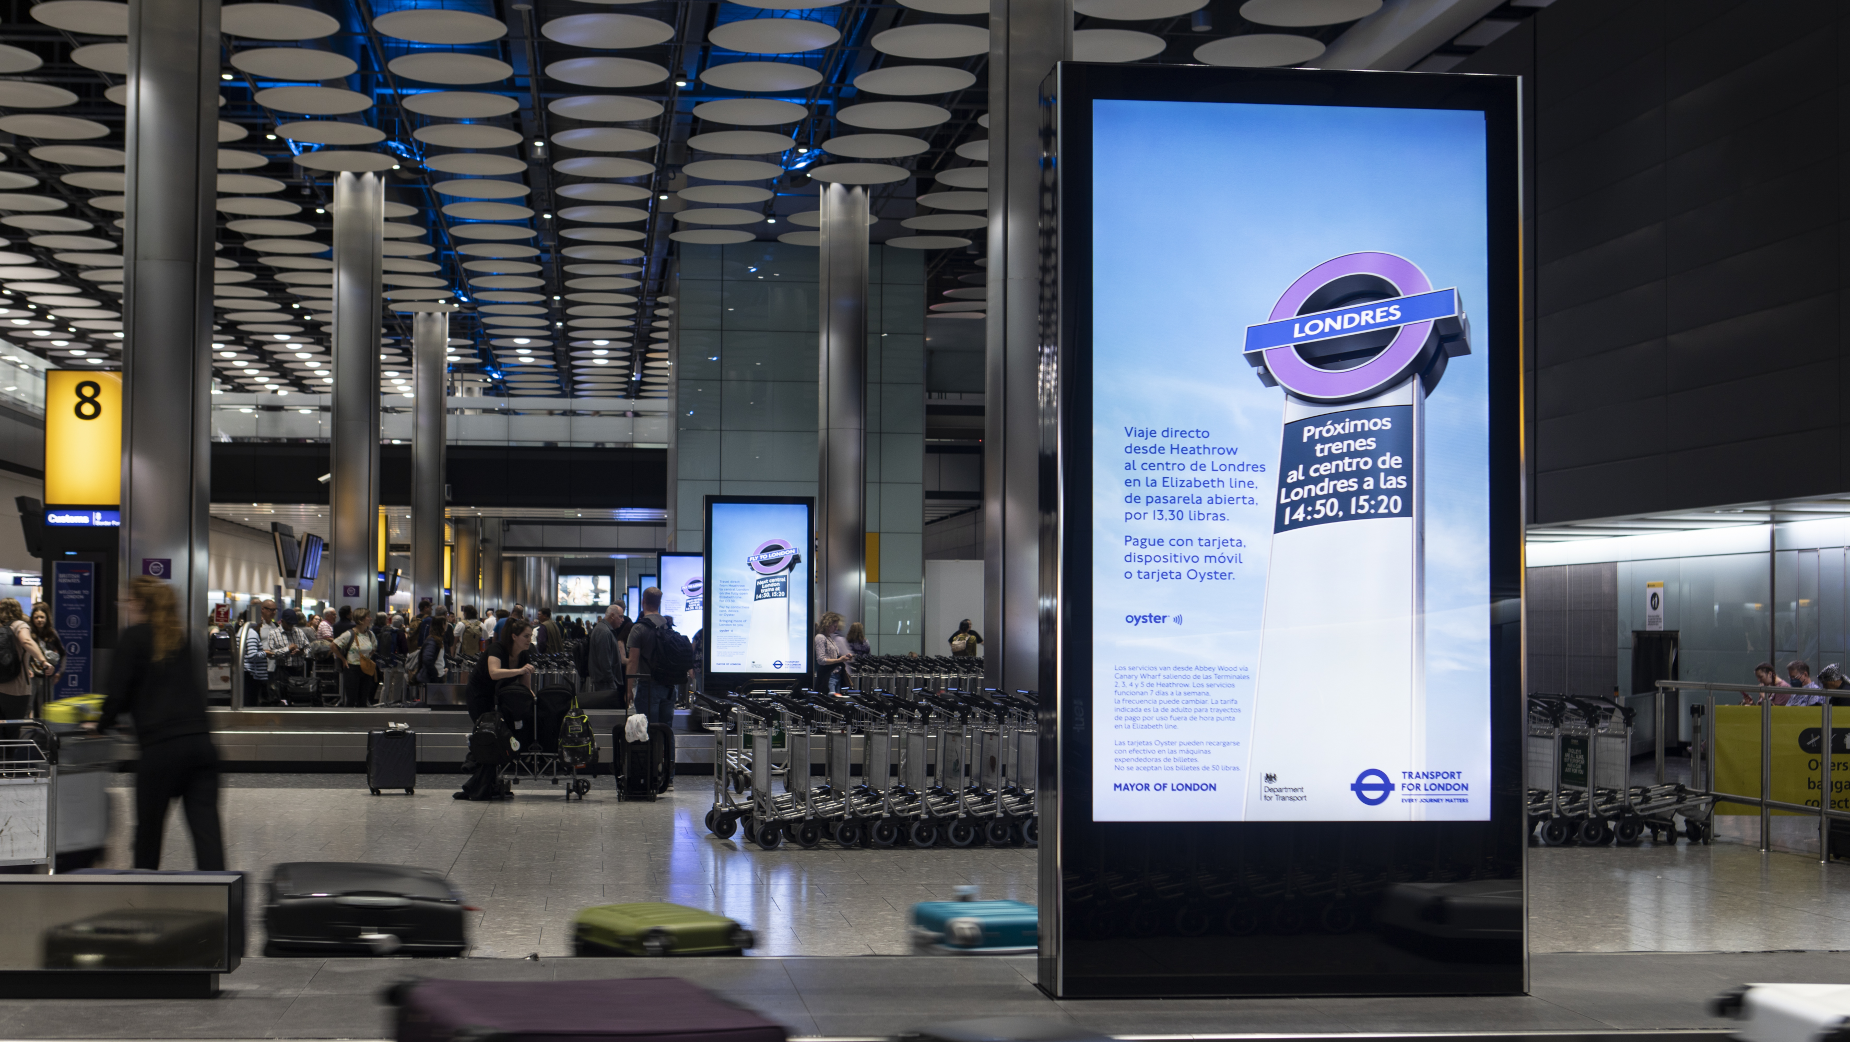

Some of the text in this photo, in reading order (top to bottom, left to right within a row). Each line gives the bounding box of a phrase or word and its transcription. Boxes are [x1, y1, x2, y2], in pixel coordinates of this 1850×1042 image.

[1293, 304, 1402, 338] LONDRES
[74, 380, 102, 420] 8
[1124, 427, 1210, 440] Viaje directo
[1302, 418, 1392, 442] Próximos
[1124, 443, 1238, 455] desde Heathrow
[1315, 437, 1376, 457] trenes
[1124, 460, 1266, 472] al centro de Londres
[1286, 452, 1402, 483] al centro de
[1124, 477, 1257, 489] en la Elizabeth line,
[1280, 472, 1407, 504] Londres a las
[1124, 493, 1258, 506] de pasarela abierta,
[1124, 510, 1229, 522] por 13,30 libras.
[1284, 495, 1402, 525] 14:50, 15:20
[48, 513, 89, 523] Customs
[1124, 535, 1164, 549] Pague
[1197, 537, 1246, 549] tarjeta,
[769, 549, 795, 558] LONDON
[1124, 552, 1243, 565] dispositivo móvil
[1124, 569, 1235, 582] o tarjeta Oyster.
[1125, 612, 1167, 626] oyster
[1194, 664, 1216, 673] Abbey
[1114, 672, 1138, 681] Canary
[1153, 739, 1177, 748] Oyster
[1401, 771, 1462, 779] TRANSPORT
[1113, 783, 1216, 791] MAYOR OF LONDON
[1264, 786, 1304, 795] Department
[1401, 783, 1468, 791] FOR LONDON
[1274, 794, 1307, 802] Transport
